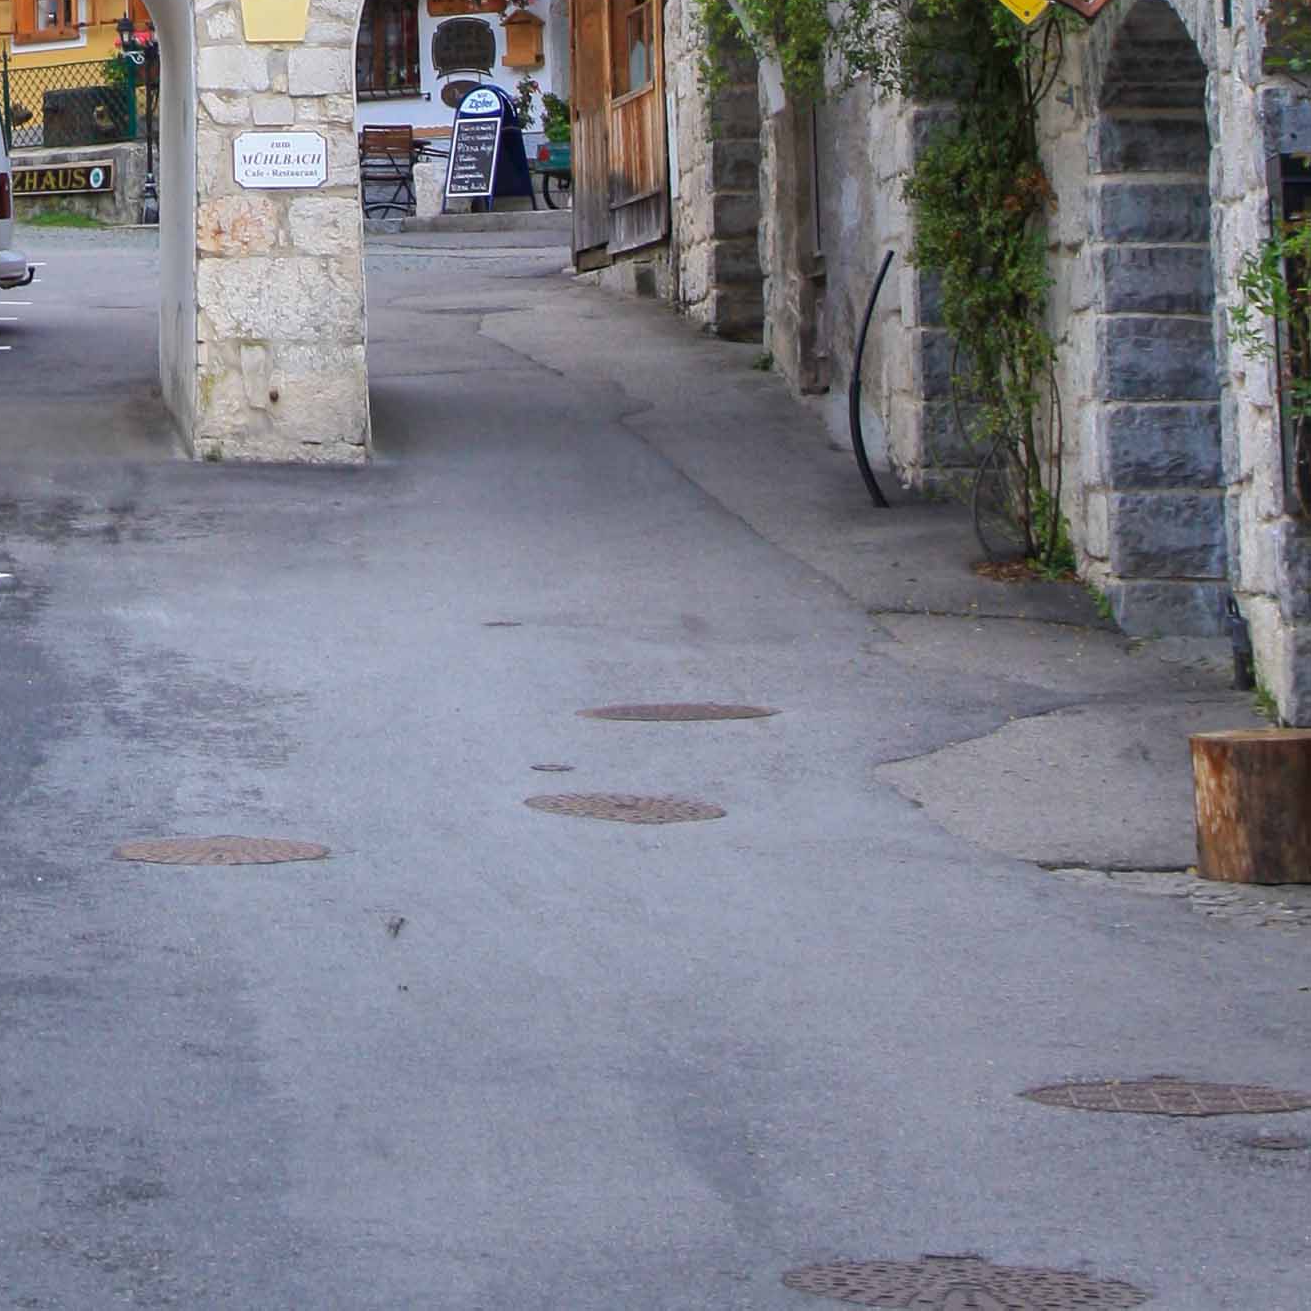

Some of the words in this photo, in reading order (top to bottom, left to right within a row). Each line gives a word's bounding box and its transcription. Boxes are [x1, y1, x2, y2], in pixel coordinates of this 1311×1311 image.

[469, 97, 494, 111] Zipfer
[270, 141, 291, 149] zum
[241, 152, 323, 165] MÜHLBACH
[272, 169, 318, 178] Restaurant
